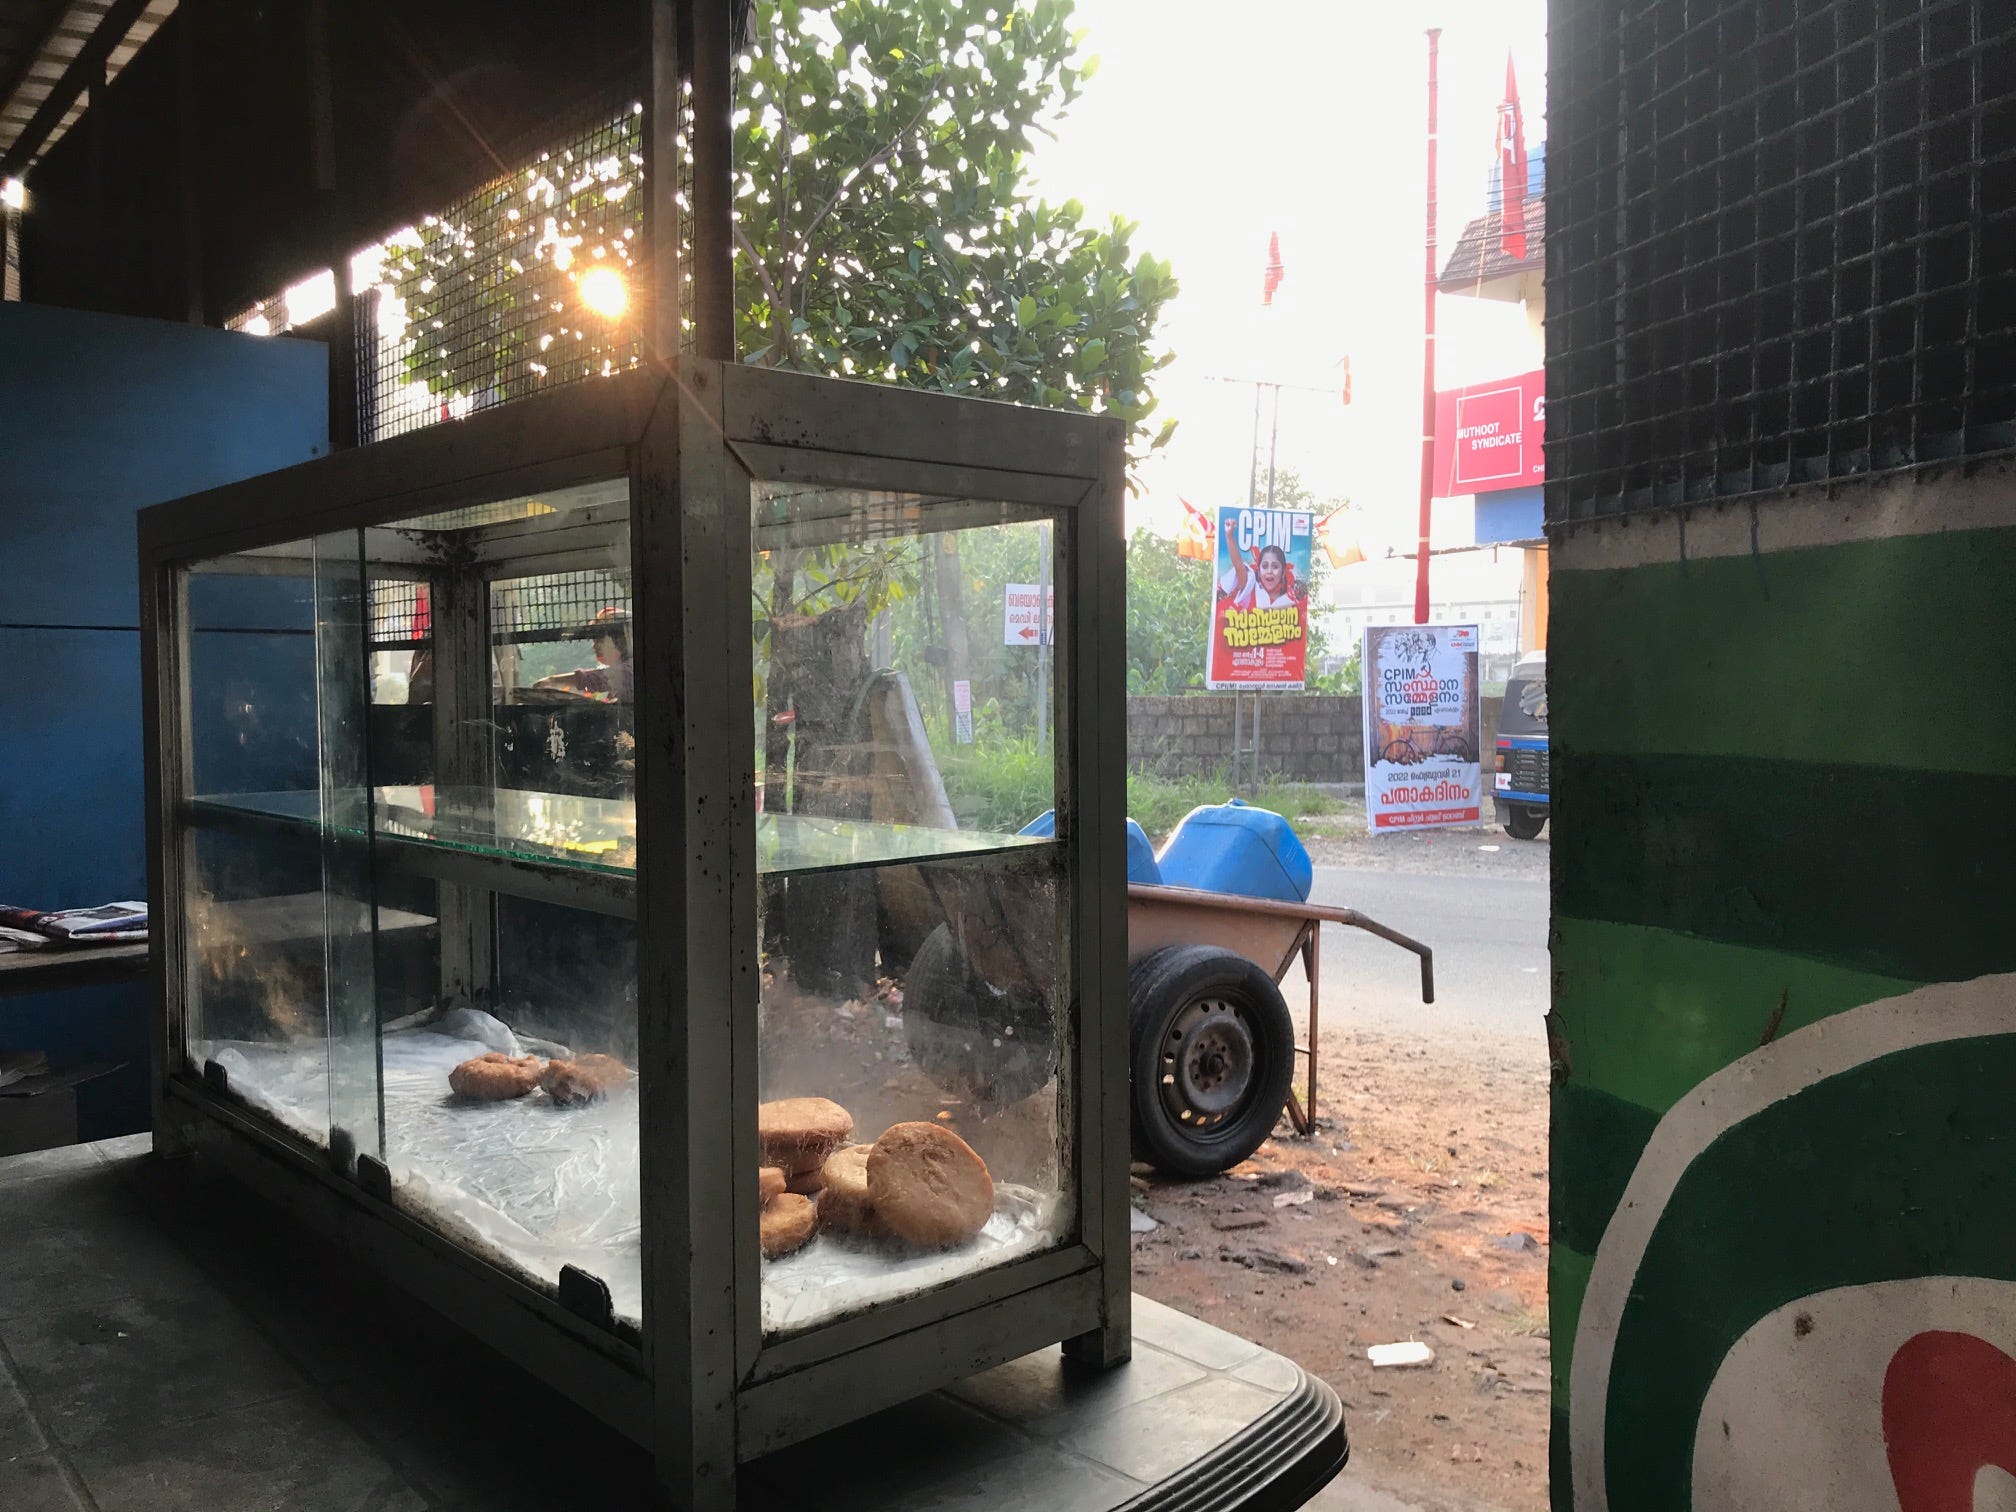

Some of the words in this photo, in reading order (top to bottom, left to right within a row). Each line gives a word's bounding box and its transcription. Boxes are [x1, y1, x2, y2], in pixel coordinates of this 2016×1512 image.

[1457, 422, 1500, 439] MUTHOOT
[1472, 432, 1522, 451] SYNDICATE
[1238, 509, 1291, 553] CPIM
[1384, 668, 1415, 681] CPIM
[1384, 678, 1459, 693] സംസ്ഥാന
[1385, 691, 1460, 707] സമ്മേളനം
[1387, 772, 1409, 782] 2022
[1451, 769, 1461, 778] 21
[1381, 780, 1470, 805] പതാകദിനം
